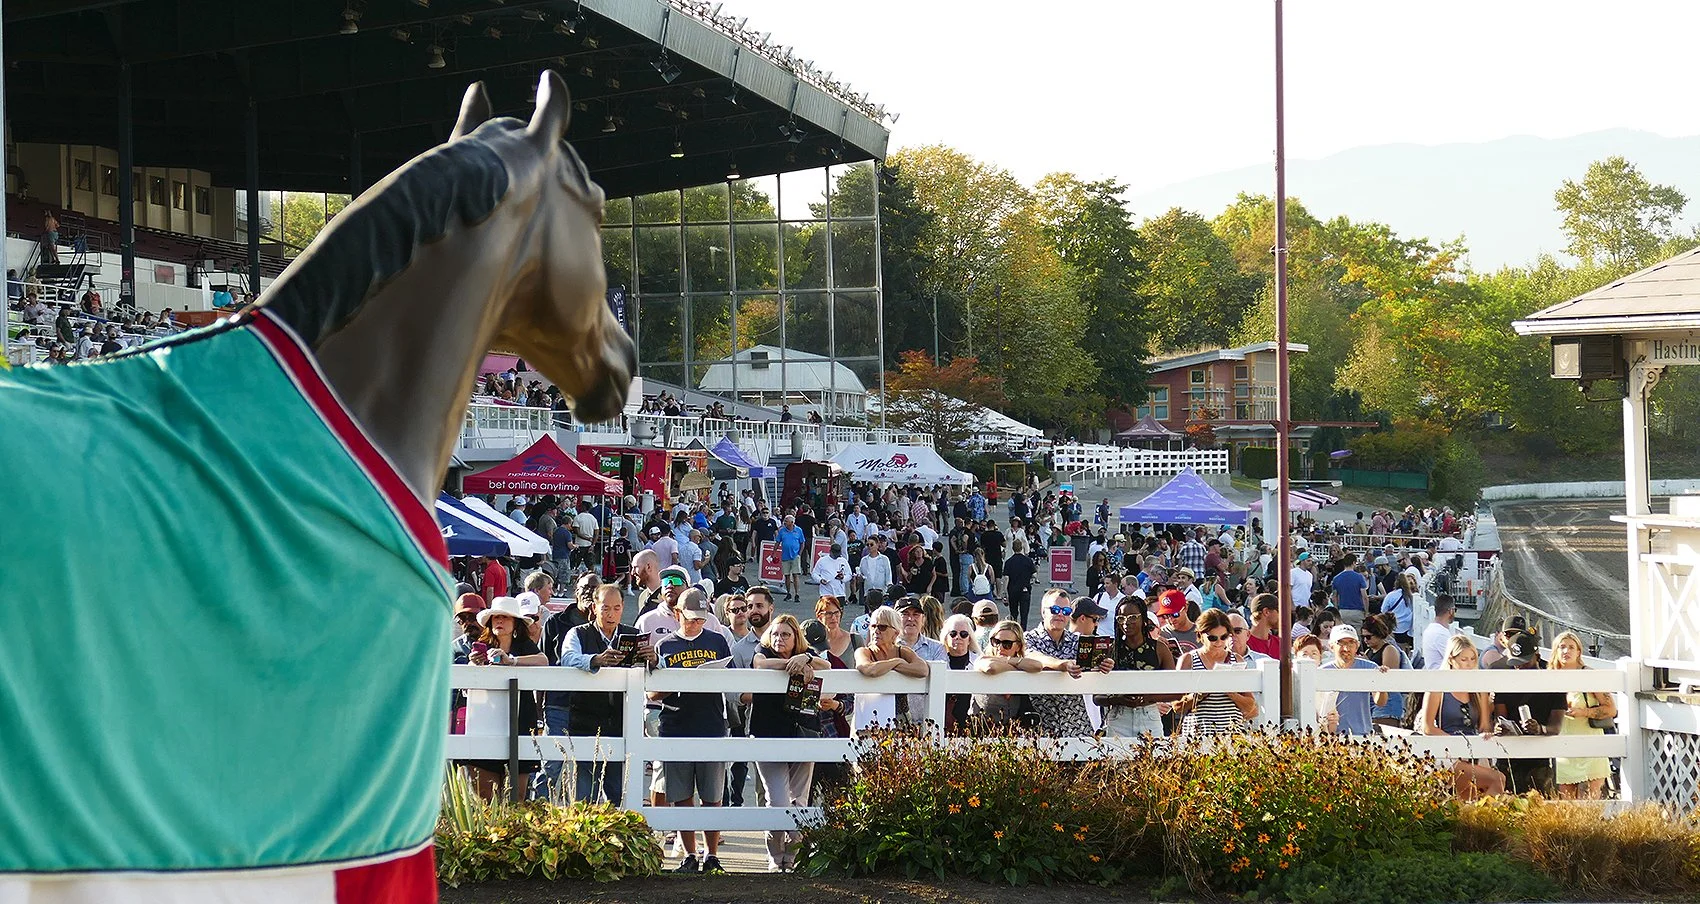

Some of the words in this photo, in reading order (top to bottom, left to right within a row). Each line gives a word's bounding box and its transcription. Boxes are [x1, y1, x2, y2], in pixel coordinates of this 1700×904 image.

[602, 460, 620, 468] food
[855, 458, 918, 471] Molson
[488, 480, 506, 489] bet
[508, 480, 538, 490] online
[540, 482, 580, 492] anytime
[615, 545, 625, 554] 10
[668, 649, 717, 667] MICHIGAN
